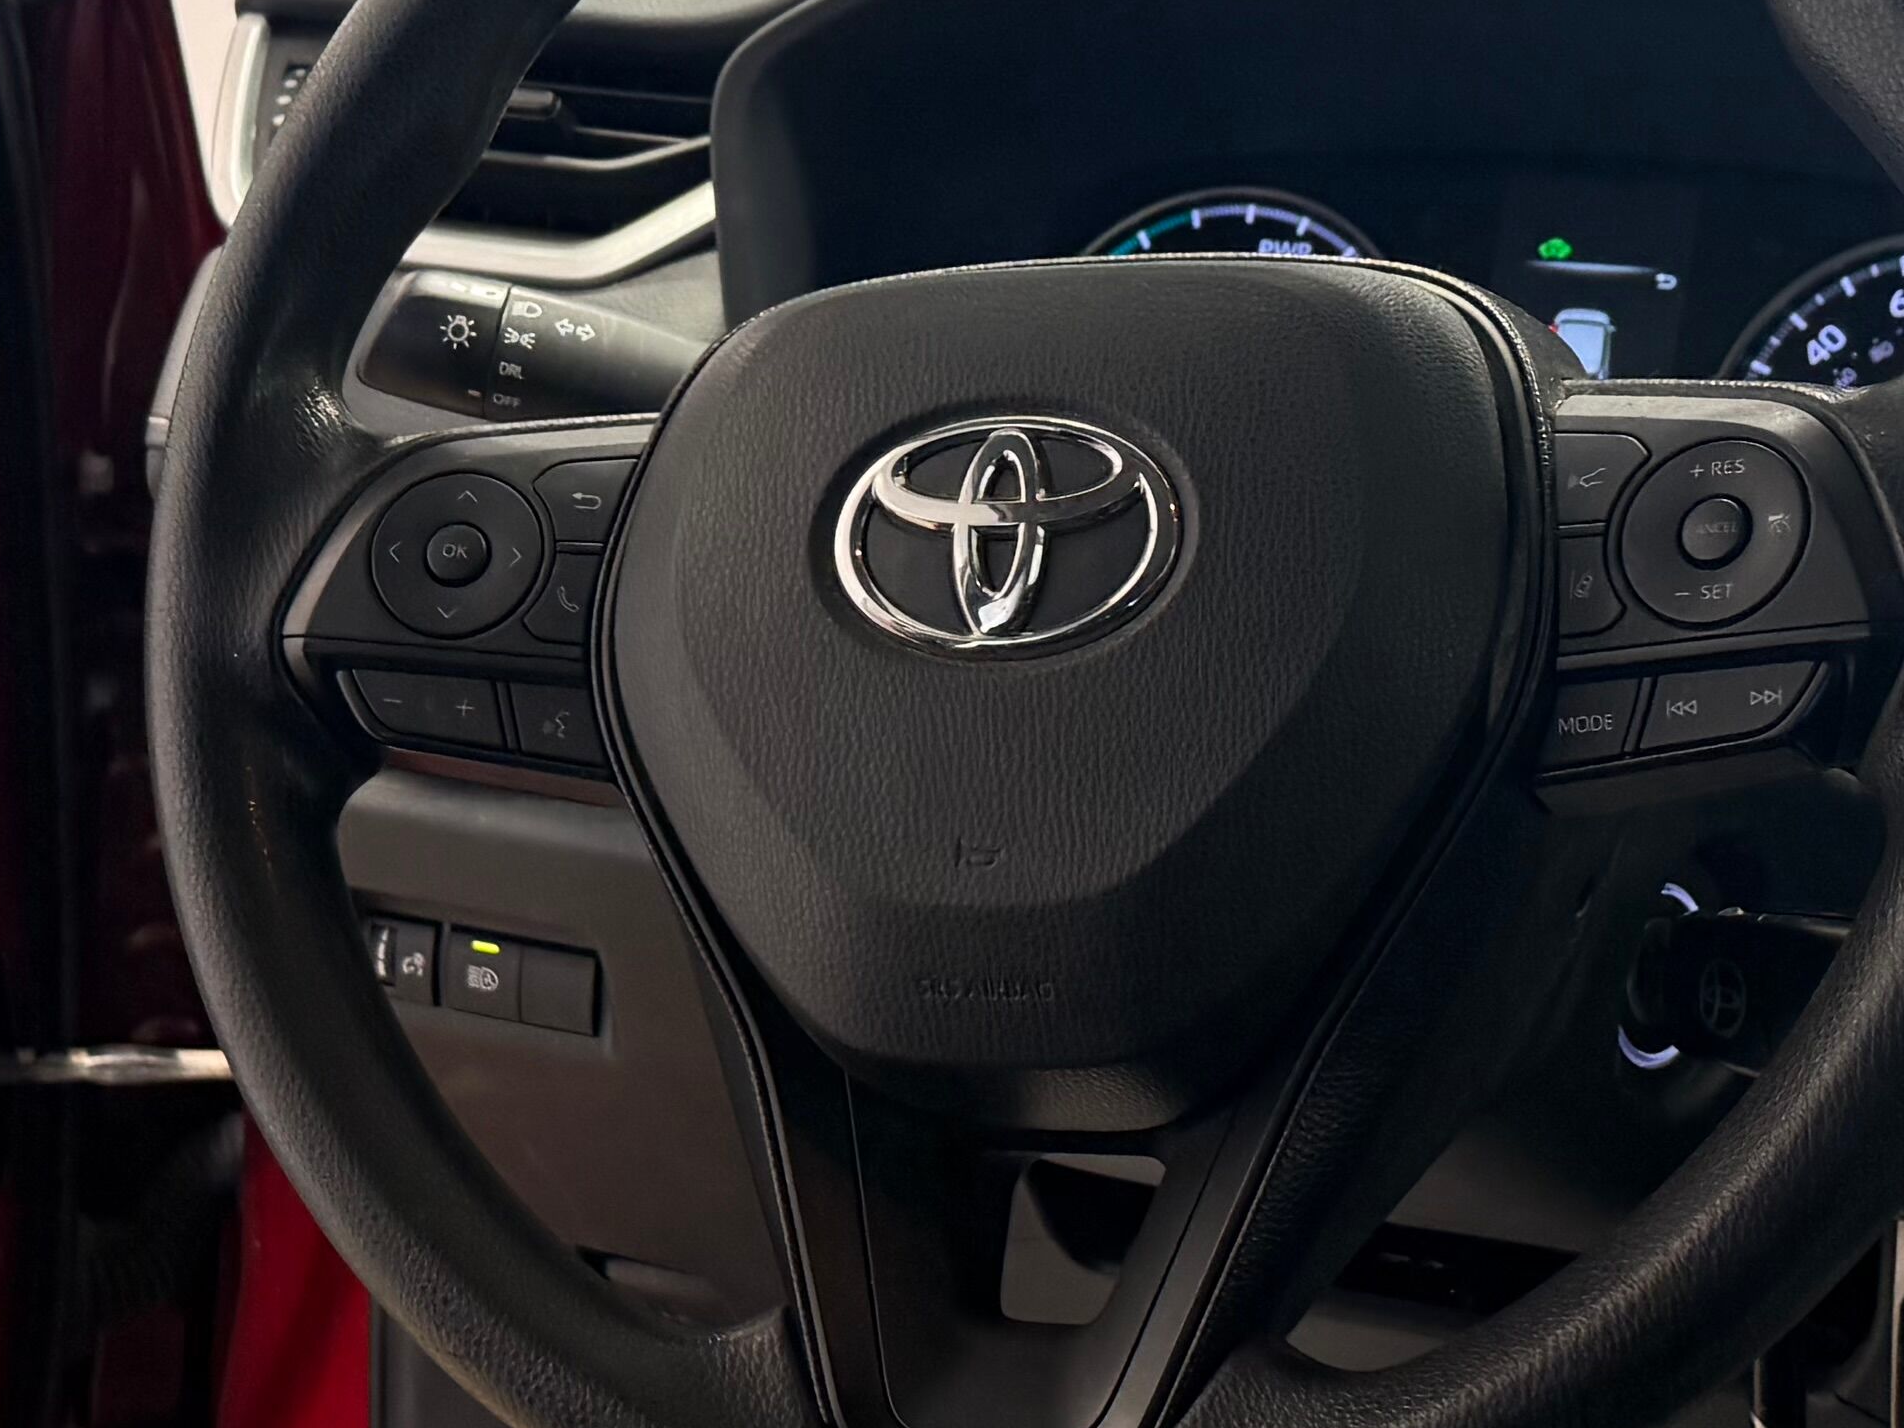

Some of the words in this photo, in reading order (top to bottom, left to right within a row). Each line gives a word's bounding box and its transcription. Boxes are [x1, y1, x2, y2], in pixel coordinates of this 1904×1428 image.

[1806, 323, 1848, 366] 40
[1710, 458, 1746, 478] RES
[442, 542, 468, 559] OK
[1699, 582, 1735, 601] SET
[1557, 714, 1614, 736] MODE
